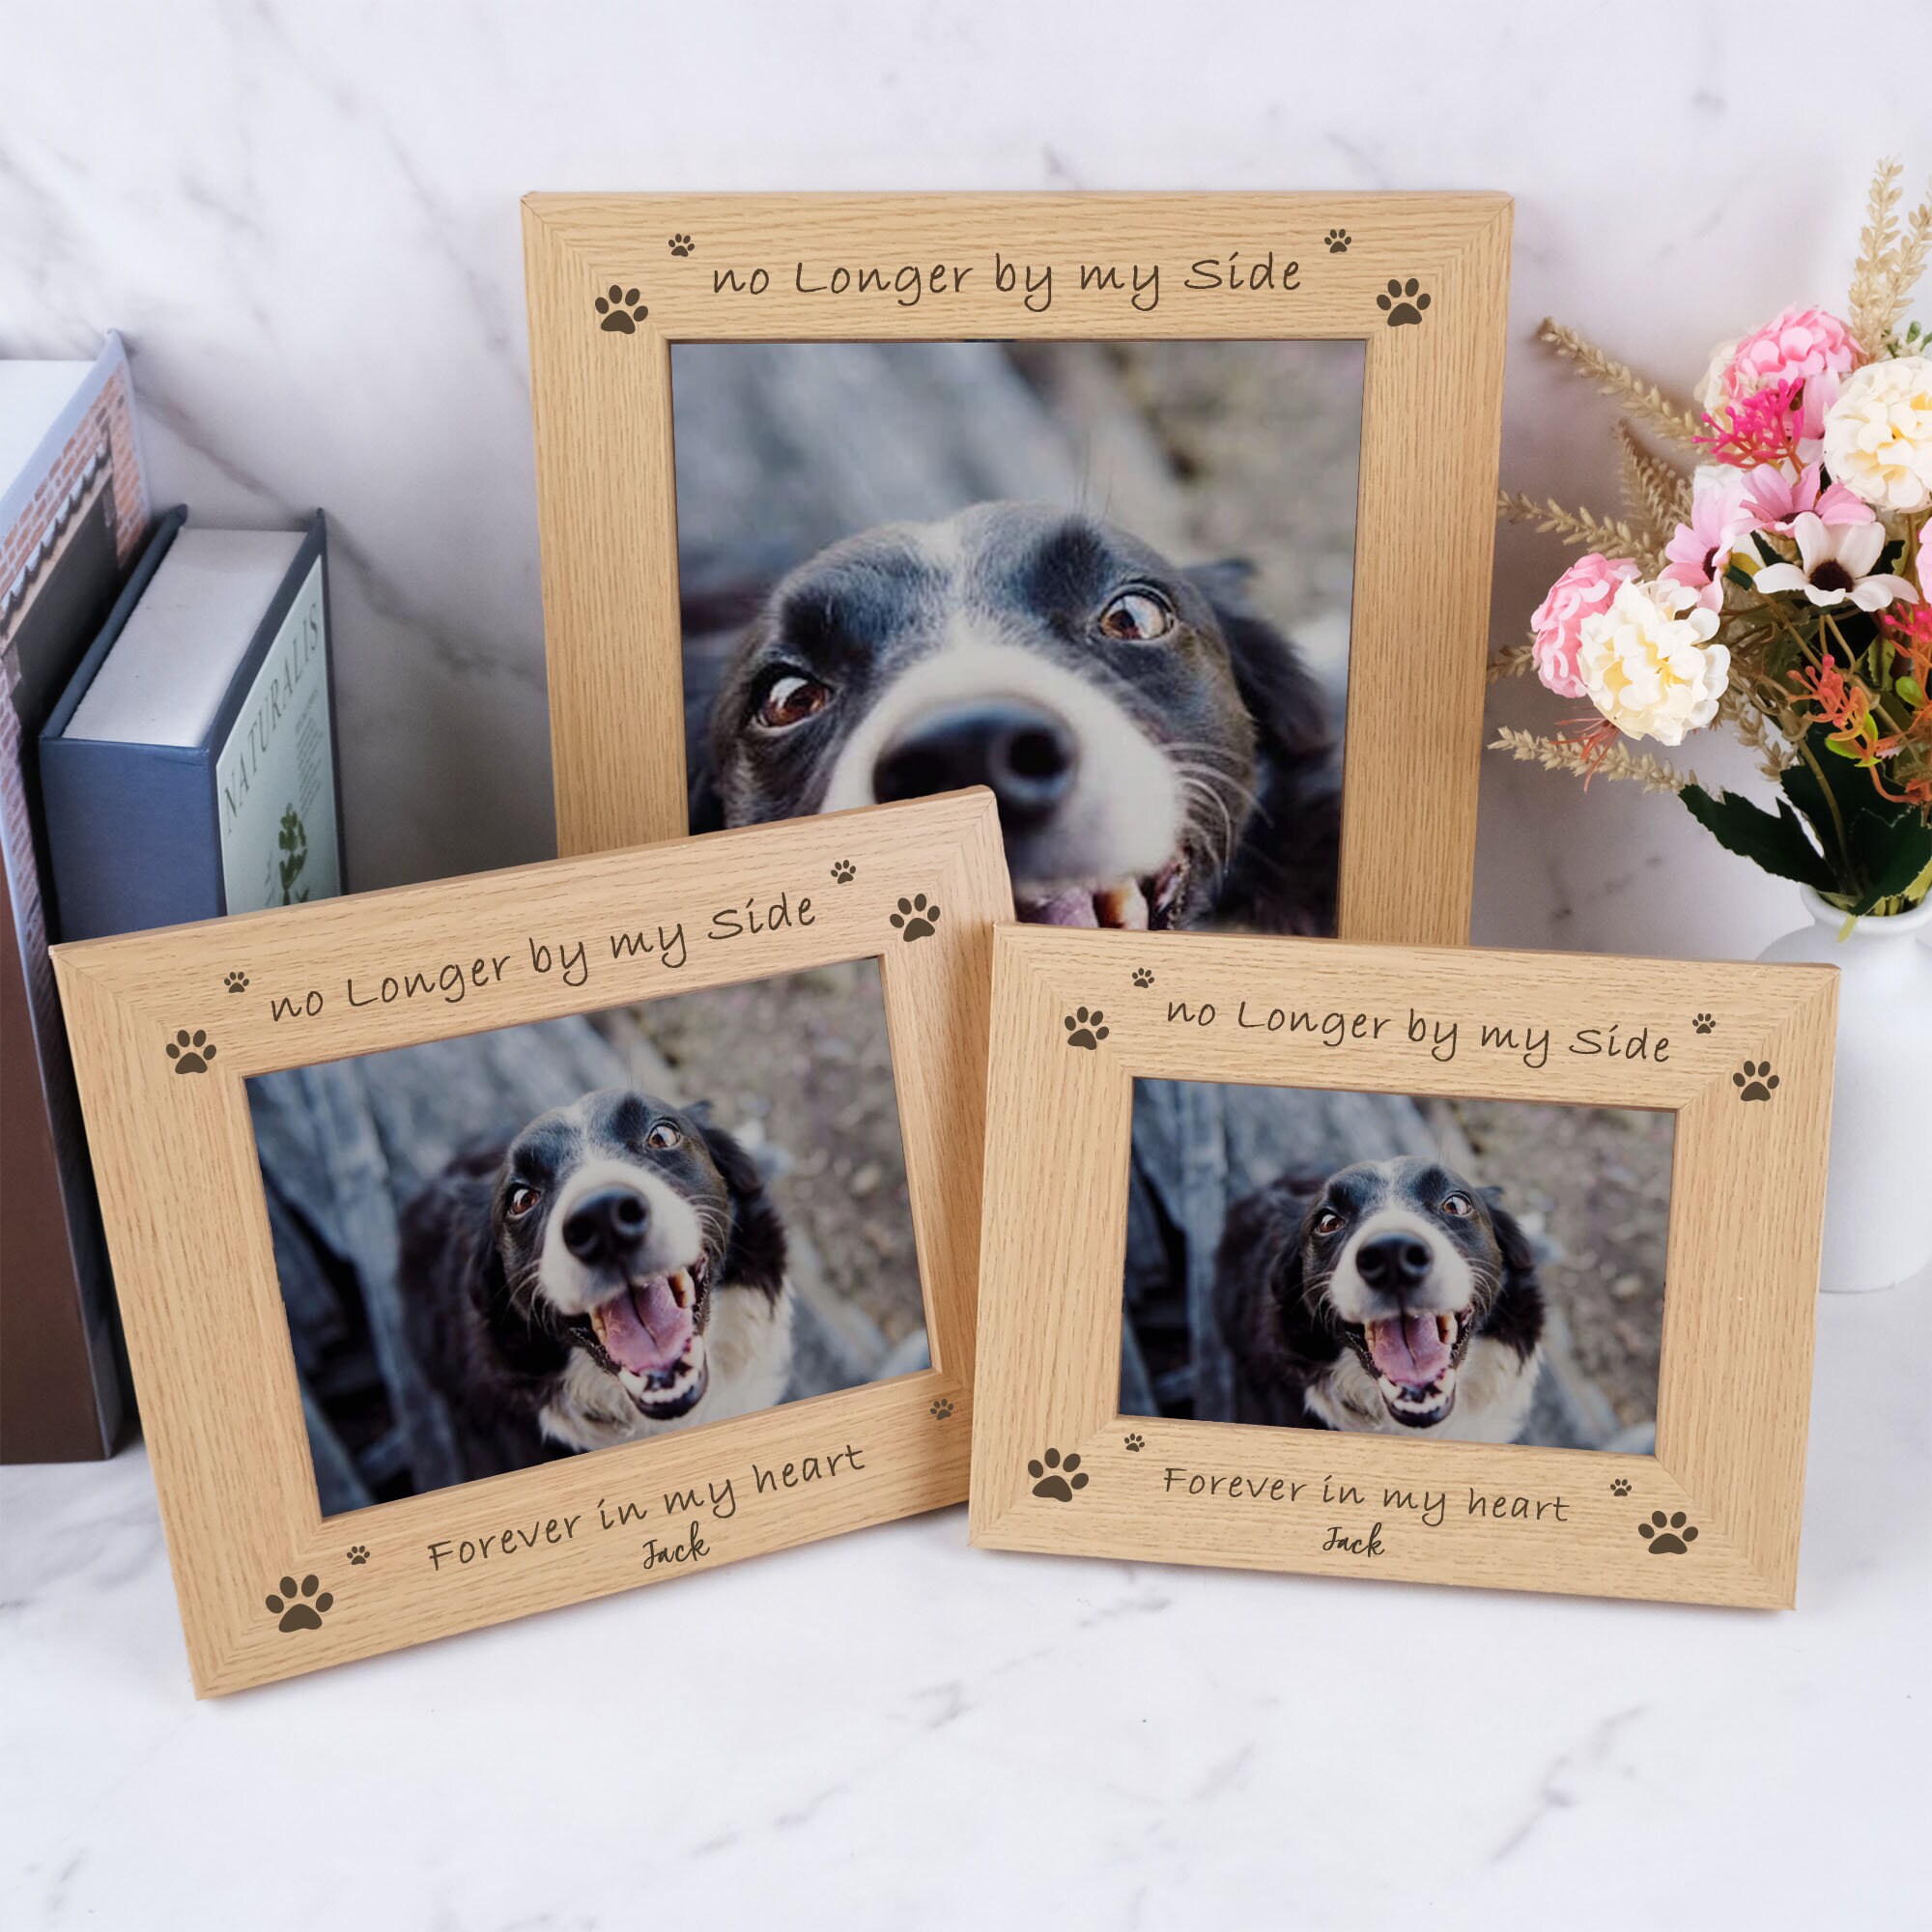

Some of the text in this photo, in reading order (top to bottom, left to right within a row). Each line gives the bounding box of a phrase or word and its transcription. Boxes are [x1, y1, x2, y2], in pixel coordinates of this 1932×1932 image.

[713, 251, 1301, 313] no Longer by my Side
[223, 602, 320, 834] NATURALIS
[270, 892, 815, 1022] no Longer by my Side
[1167, 1001, 1669, 1069] no Longer by my Side
[427, 1444, 866, 1572] Forever in my heart
[1163, 1467, 1570, 1527] Forever in my heart
[642, 1520, 711, 1570] Jack
[1322, 1521, 1385, 1558] Jack
